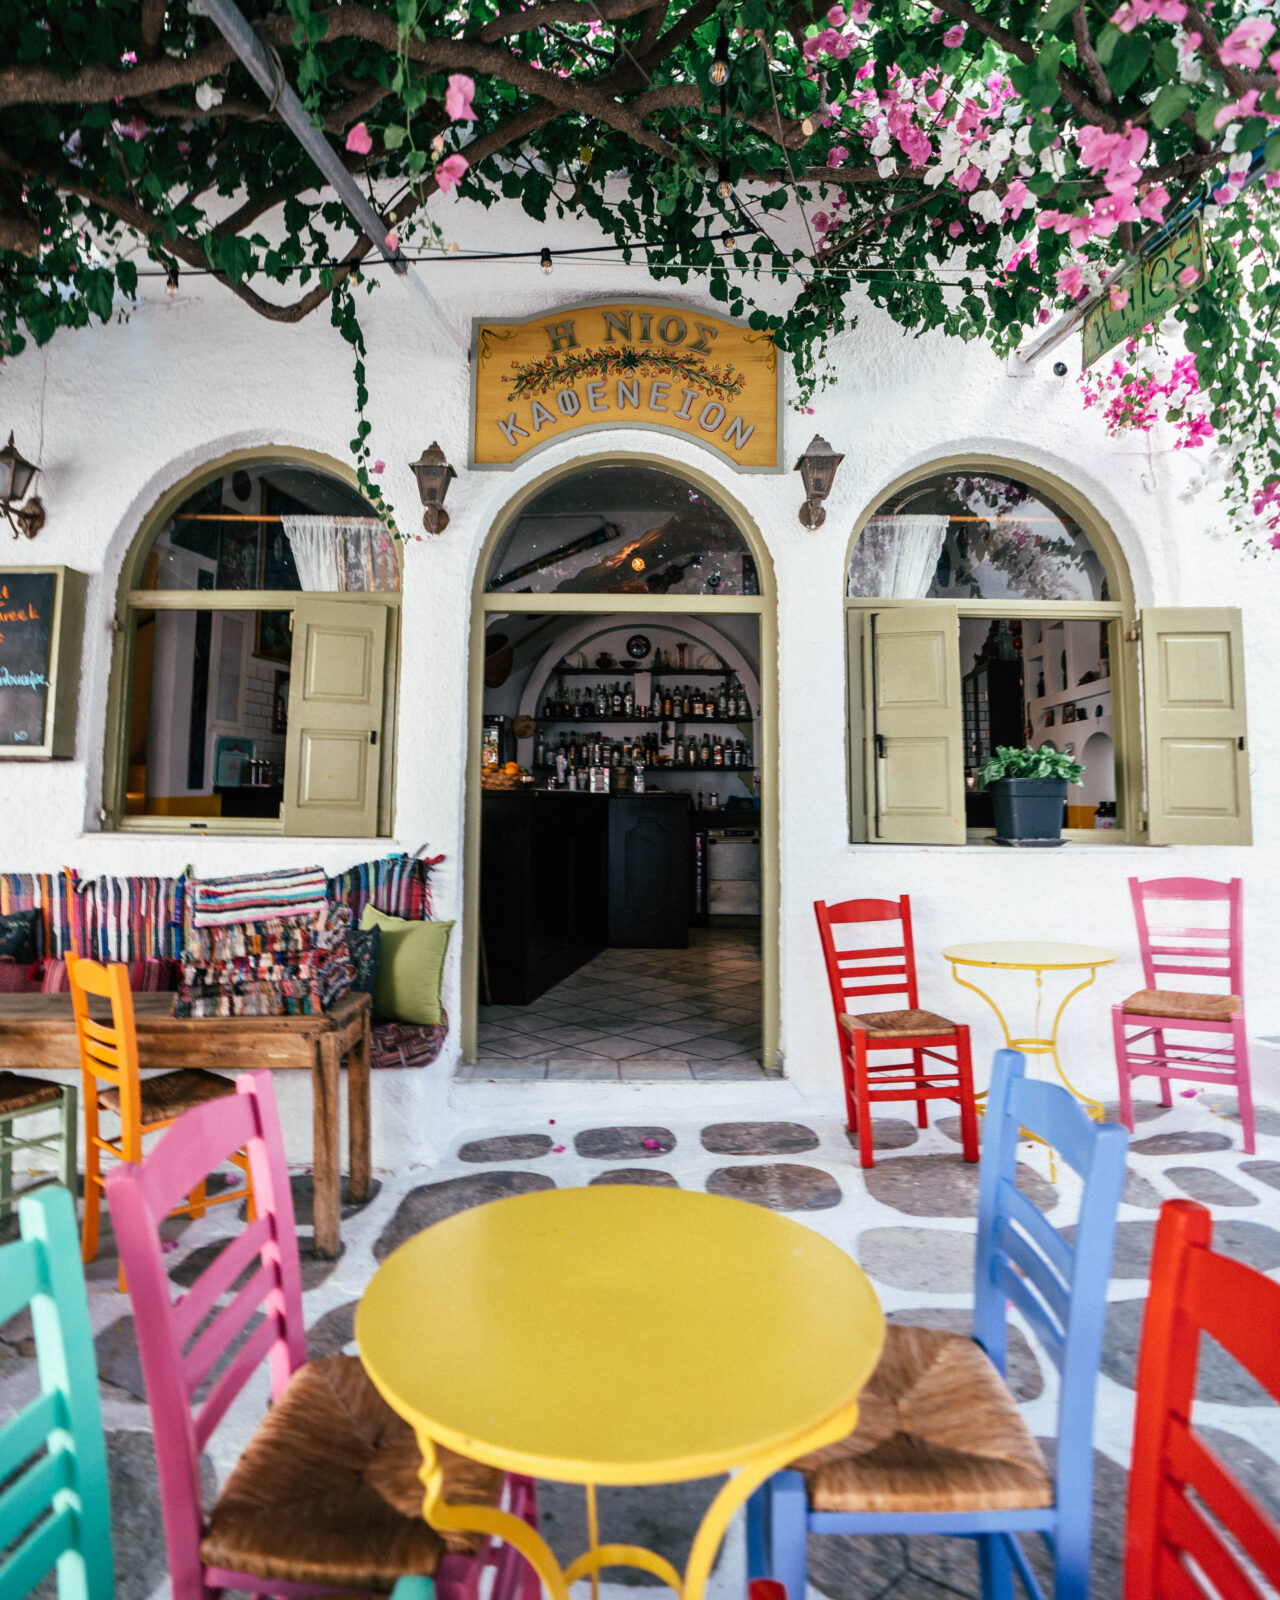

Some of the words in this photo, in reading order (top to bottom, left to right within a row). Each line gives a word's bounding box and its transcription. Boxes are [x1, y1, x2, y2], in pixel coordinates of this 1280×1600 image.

[544, 319, 581, 353] Η
[602, 310, 719, 356] ΝΙΟΣ
[497, 379, 755, 450] ΚΑΦΕΝΕΙΟΝ
